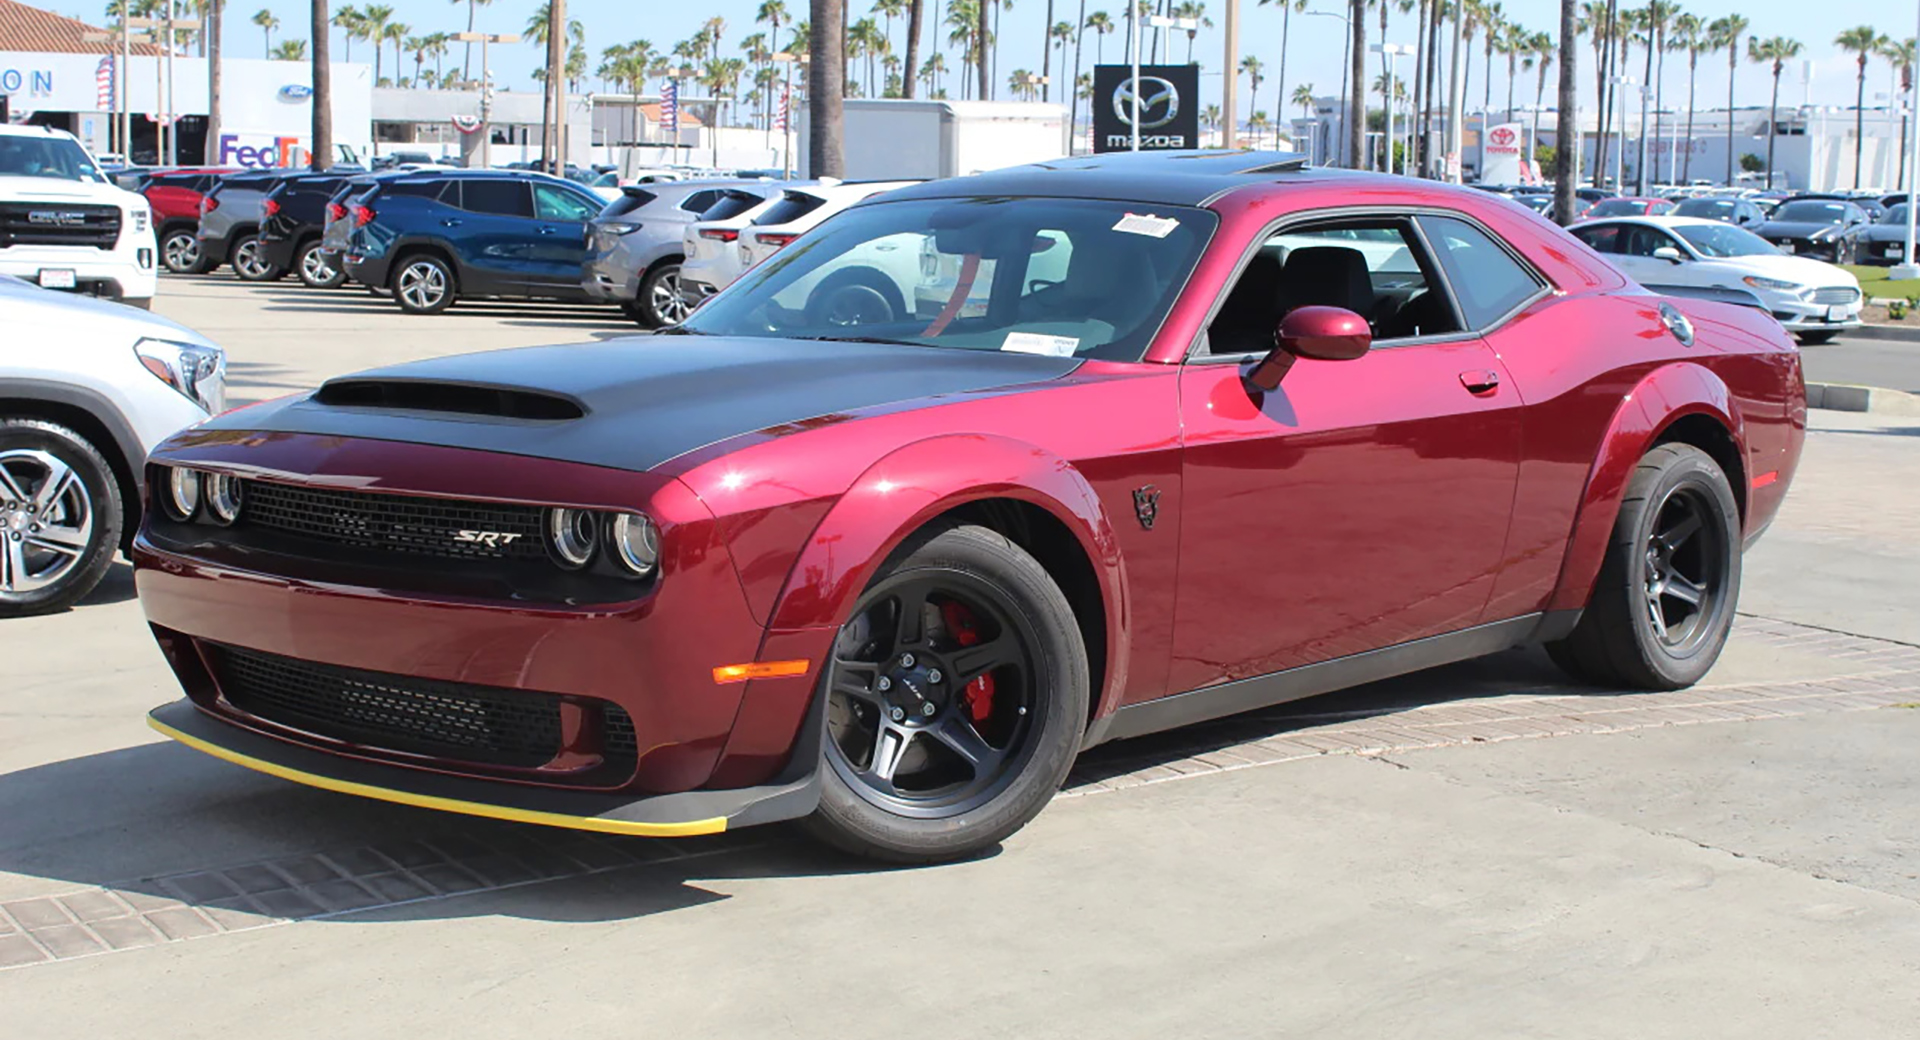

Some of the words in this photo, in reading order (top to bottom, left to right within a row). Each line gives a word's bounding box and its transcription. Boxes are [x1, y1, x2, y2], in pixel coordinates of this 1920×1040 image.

[3, 69, 52, 92] ON
[1486, 146, 1519, 154] TOYOTA
[453, 530, 522, 548] SRT
